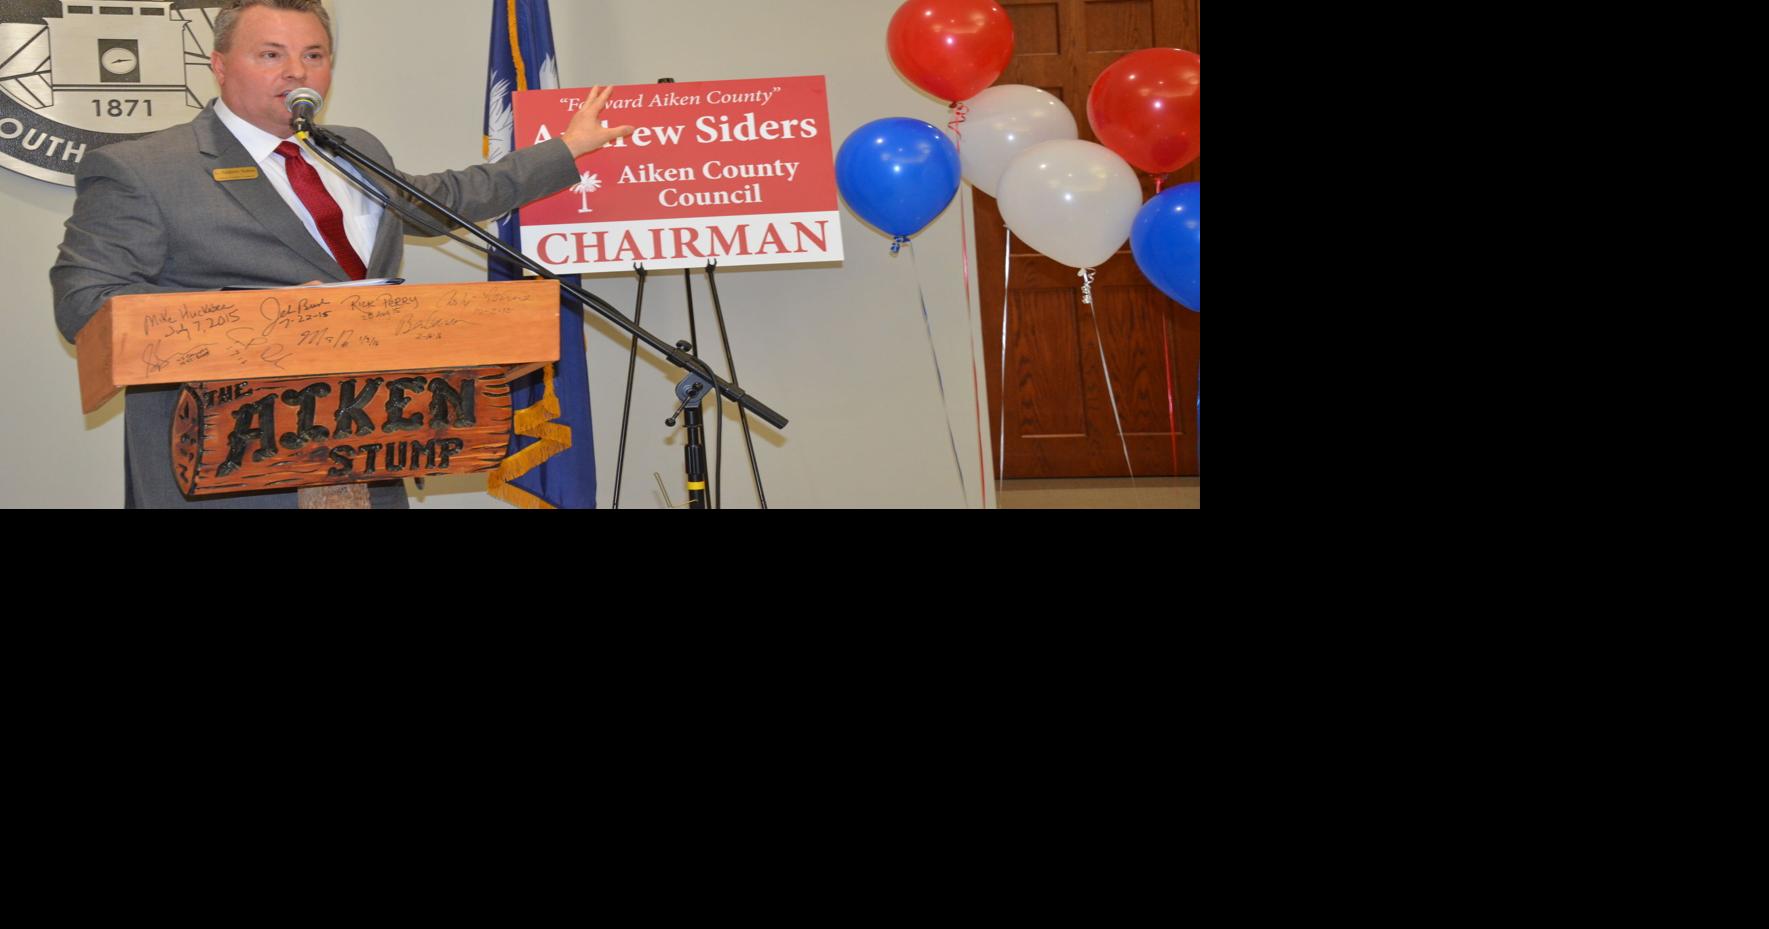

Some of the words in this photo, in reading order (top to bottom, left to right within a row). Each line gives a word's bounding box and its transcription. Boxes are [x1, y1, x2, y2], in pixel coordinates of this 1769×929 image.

[92, 99, 152, 117] 1871
[560, 94, 644, 111] “Fard
[648, 90, 702, 108] Aiken
[695, 112, 818, 144] Siders
[617, 162, 695, 184] Aiken
[702, 159, 799, 182] County
[658, 183, 762, 208] Council
[536, 220, 829, 265] CHAIRMAN
[164, 323, 192, 341] July
[206, 309, 240, 328] 2015
[204, 381, 253, 408] THE
[216, 375, 476, 477] AIKEN
[328, 437, 463, 477] STUMP
